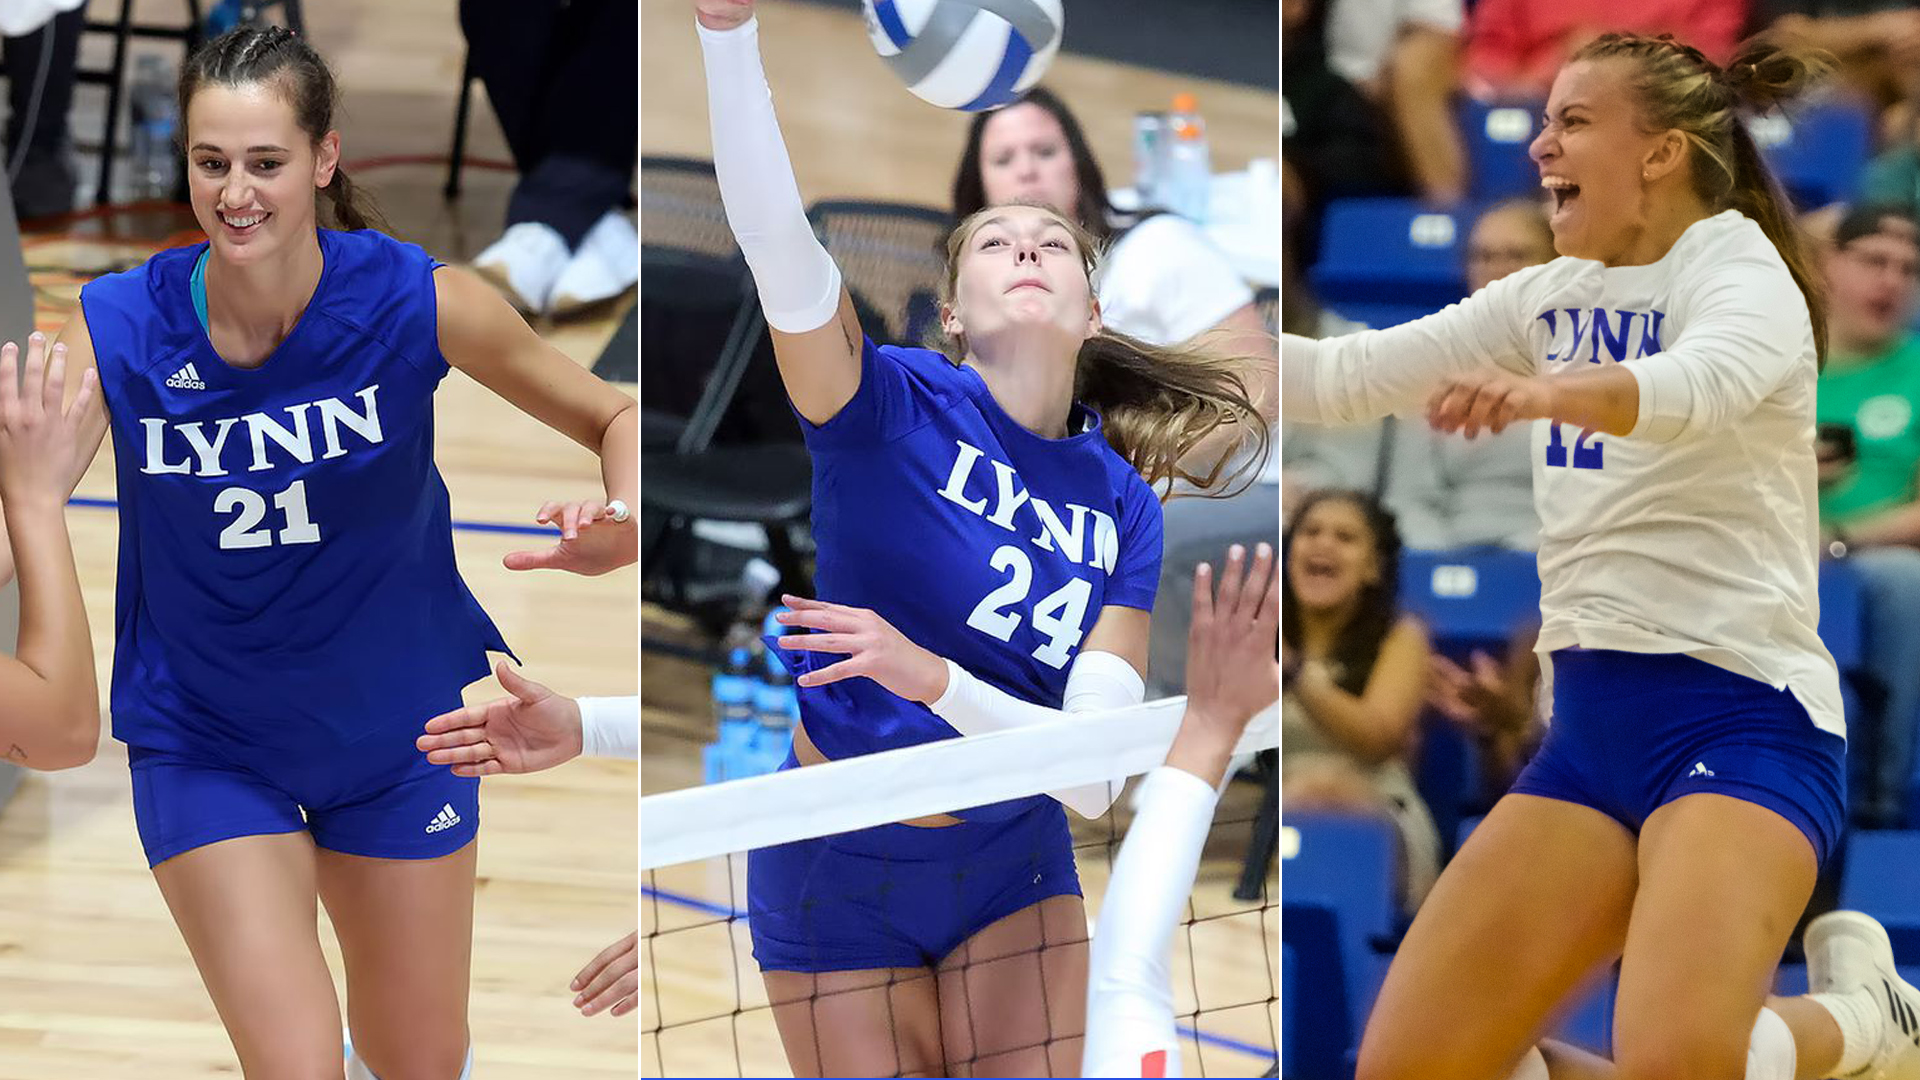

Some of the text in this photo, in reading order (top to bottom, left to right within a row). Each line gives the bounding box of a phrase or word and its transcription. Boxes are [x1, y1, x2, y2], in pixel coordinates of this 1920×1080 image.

[165, 376, 206, 391] adidas
[139, 384, 385, 477] LYNN
[213, 479, 321, 550] 21
[936, 439, 1119, 577] LYNN
[965, 544, 1093, 671] 24
[425, 815, 461, 834] adidas
